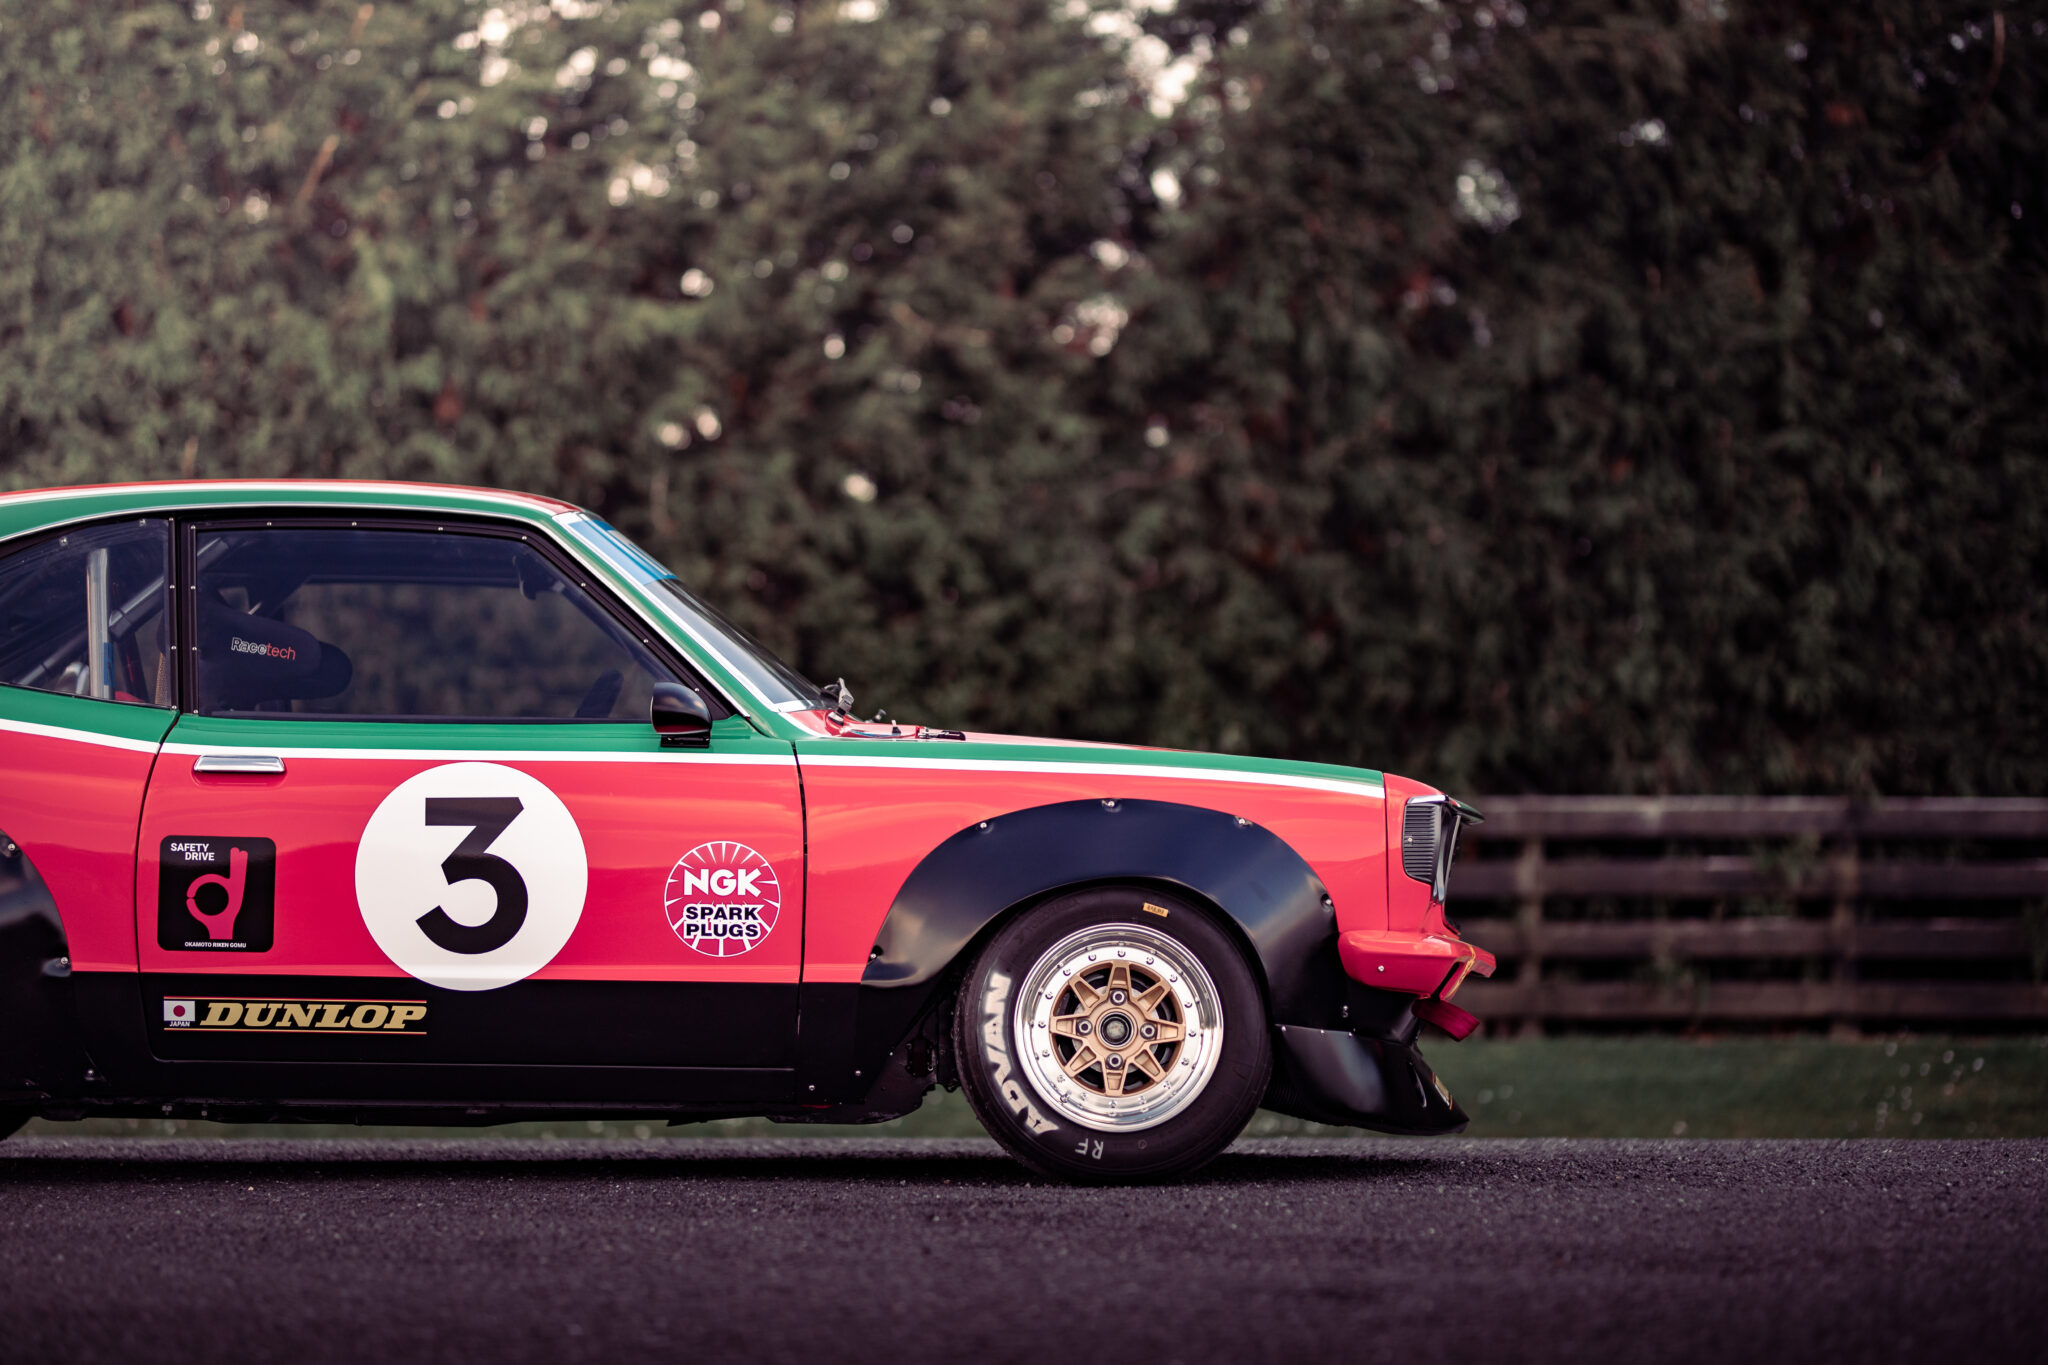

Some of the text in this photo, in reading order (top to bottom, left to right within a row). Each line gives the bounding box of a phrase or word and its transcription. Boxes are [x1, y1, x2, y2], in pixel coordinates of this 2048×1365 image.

[231, 637, 296, 661] Racetech
[170, 843, 209, 852] SAFETY
[185, 852, 215, 861] DRIVE
[416, 797, 528, 955] 3
[684, 868, 762, 897] NGK
[685, 906, 759, 921] SPARK
[686, 924, 759, 937] PLUGS
[200, 1002, 427, 1029] DUNLOP
[984, 972, 1060, 1135] ADVAN
[1074, 1137, 1104, 1160] RF
